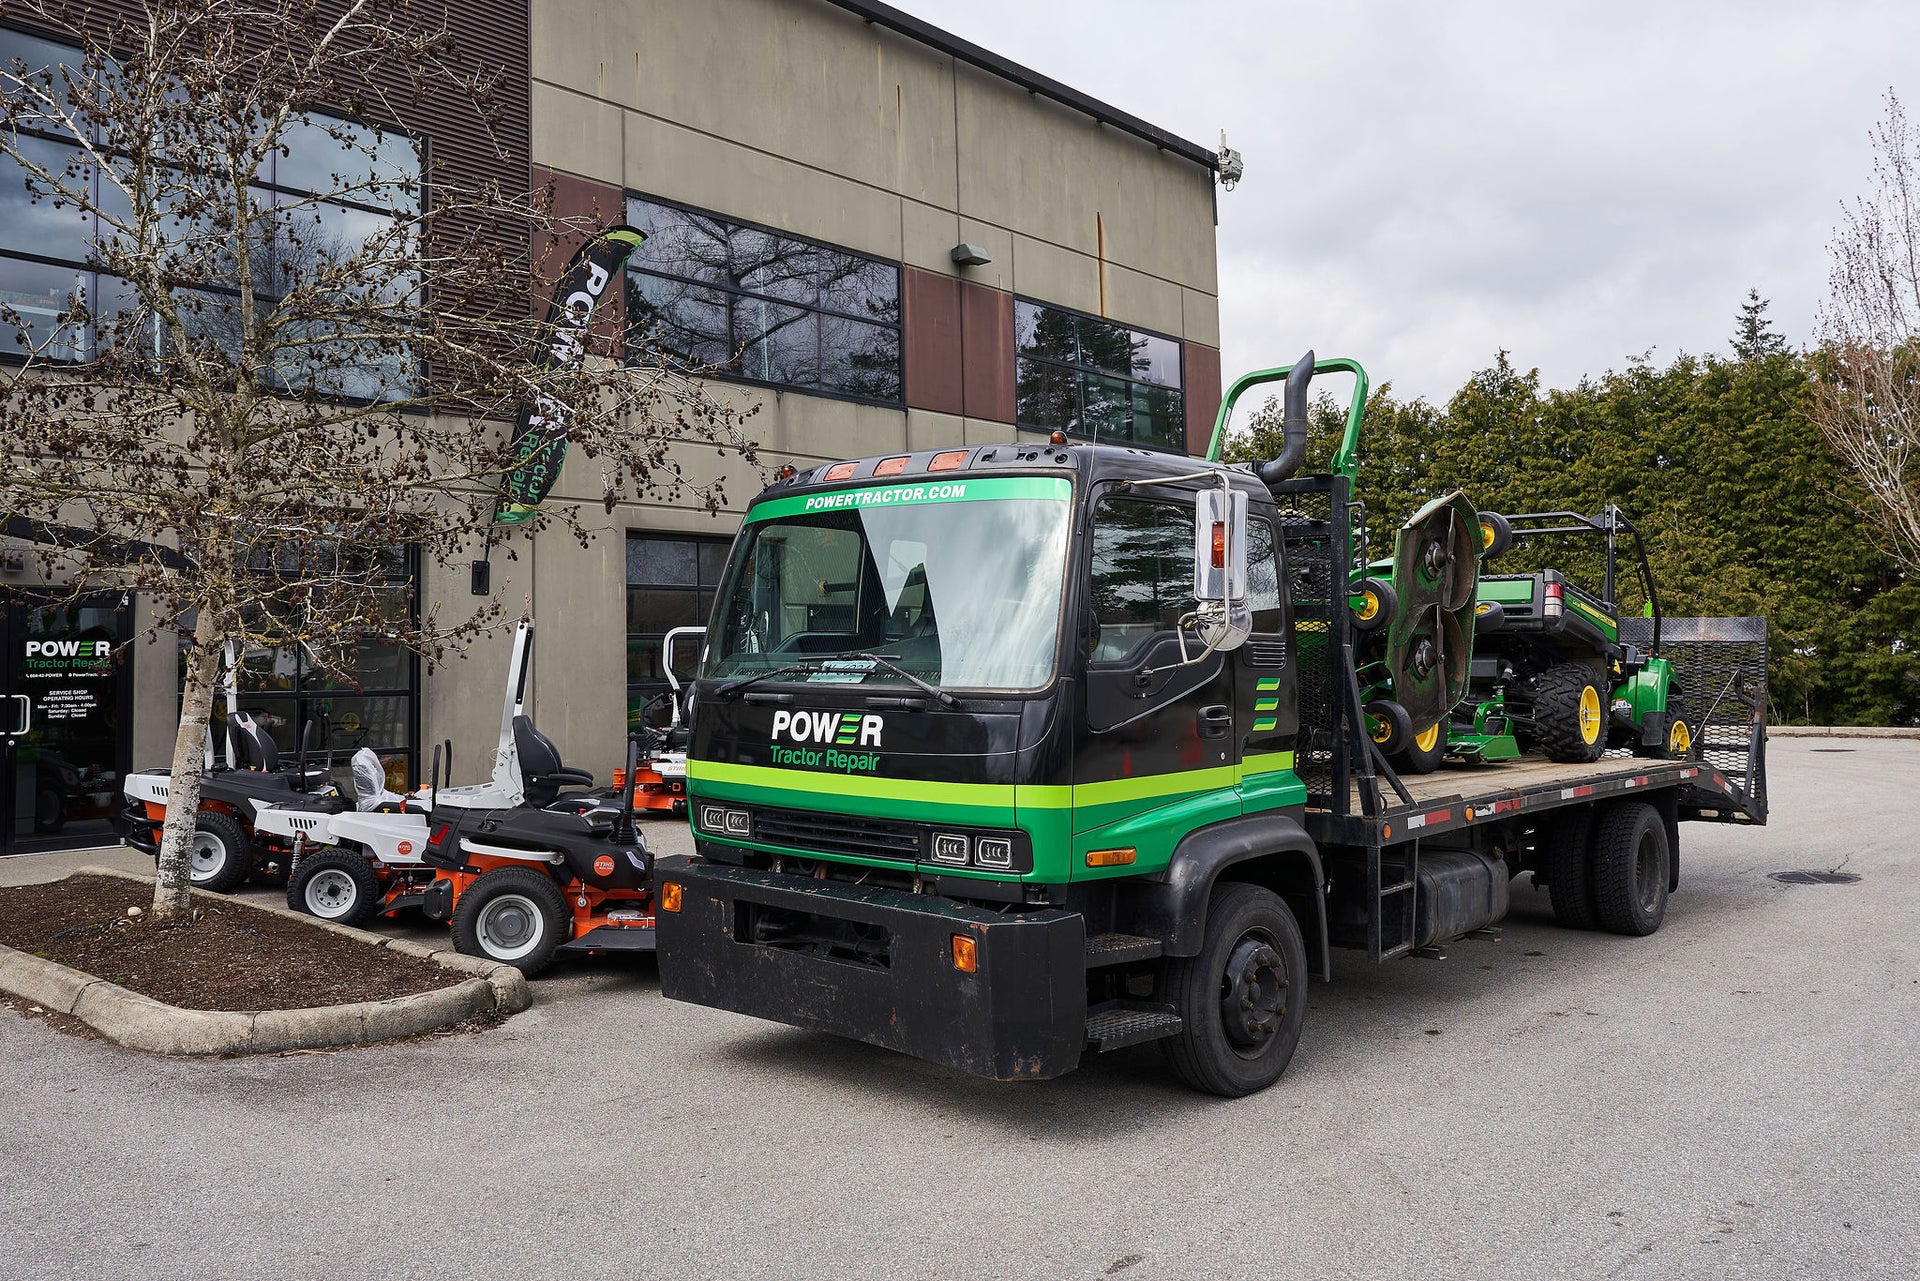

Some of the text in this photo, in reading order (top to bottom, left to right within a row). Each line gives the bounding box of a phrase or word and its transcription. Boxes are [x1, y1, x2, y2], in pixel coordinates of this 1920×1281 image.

[805, 484, 966, 510] POWERTRACTOR.COM
[26, 641, 110, 657] POWER
[27, 659, 69, 668] Tractor
[771, 710, 884, 747] POWER
[770, 745, 881, 773] Tractor Repair
